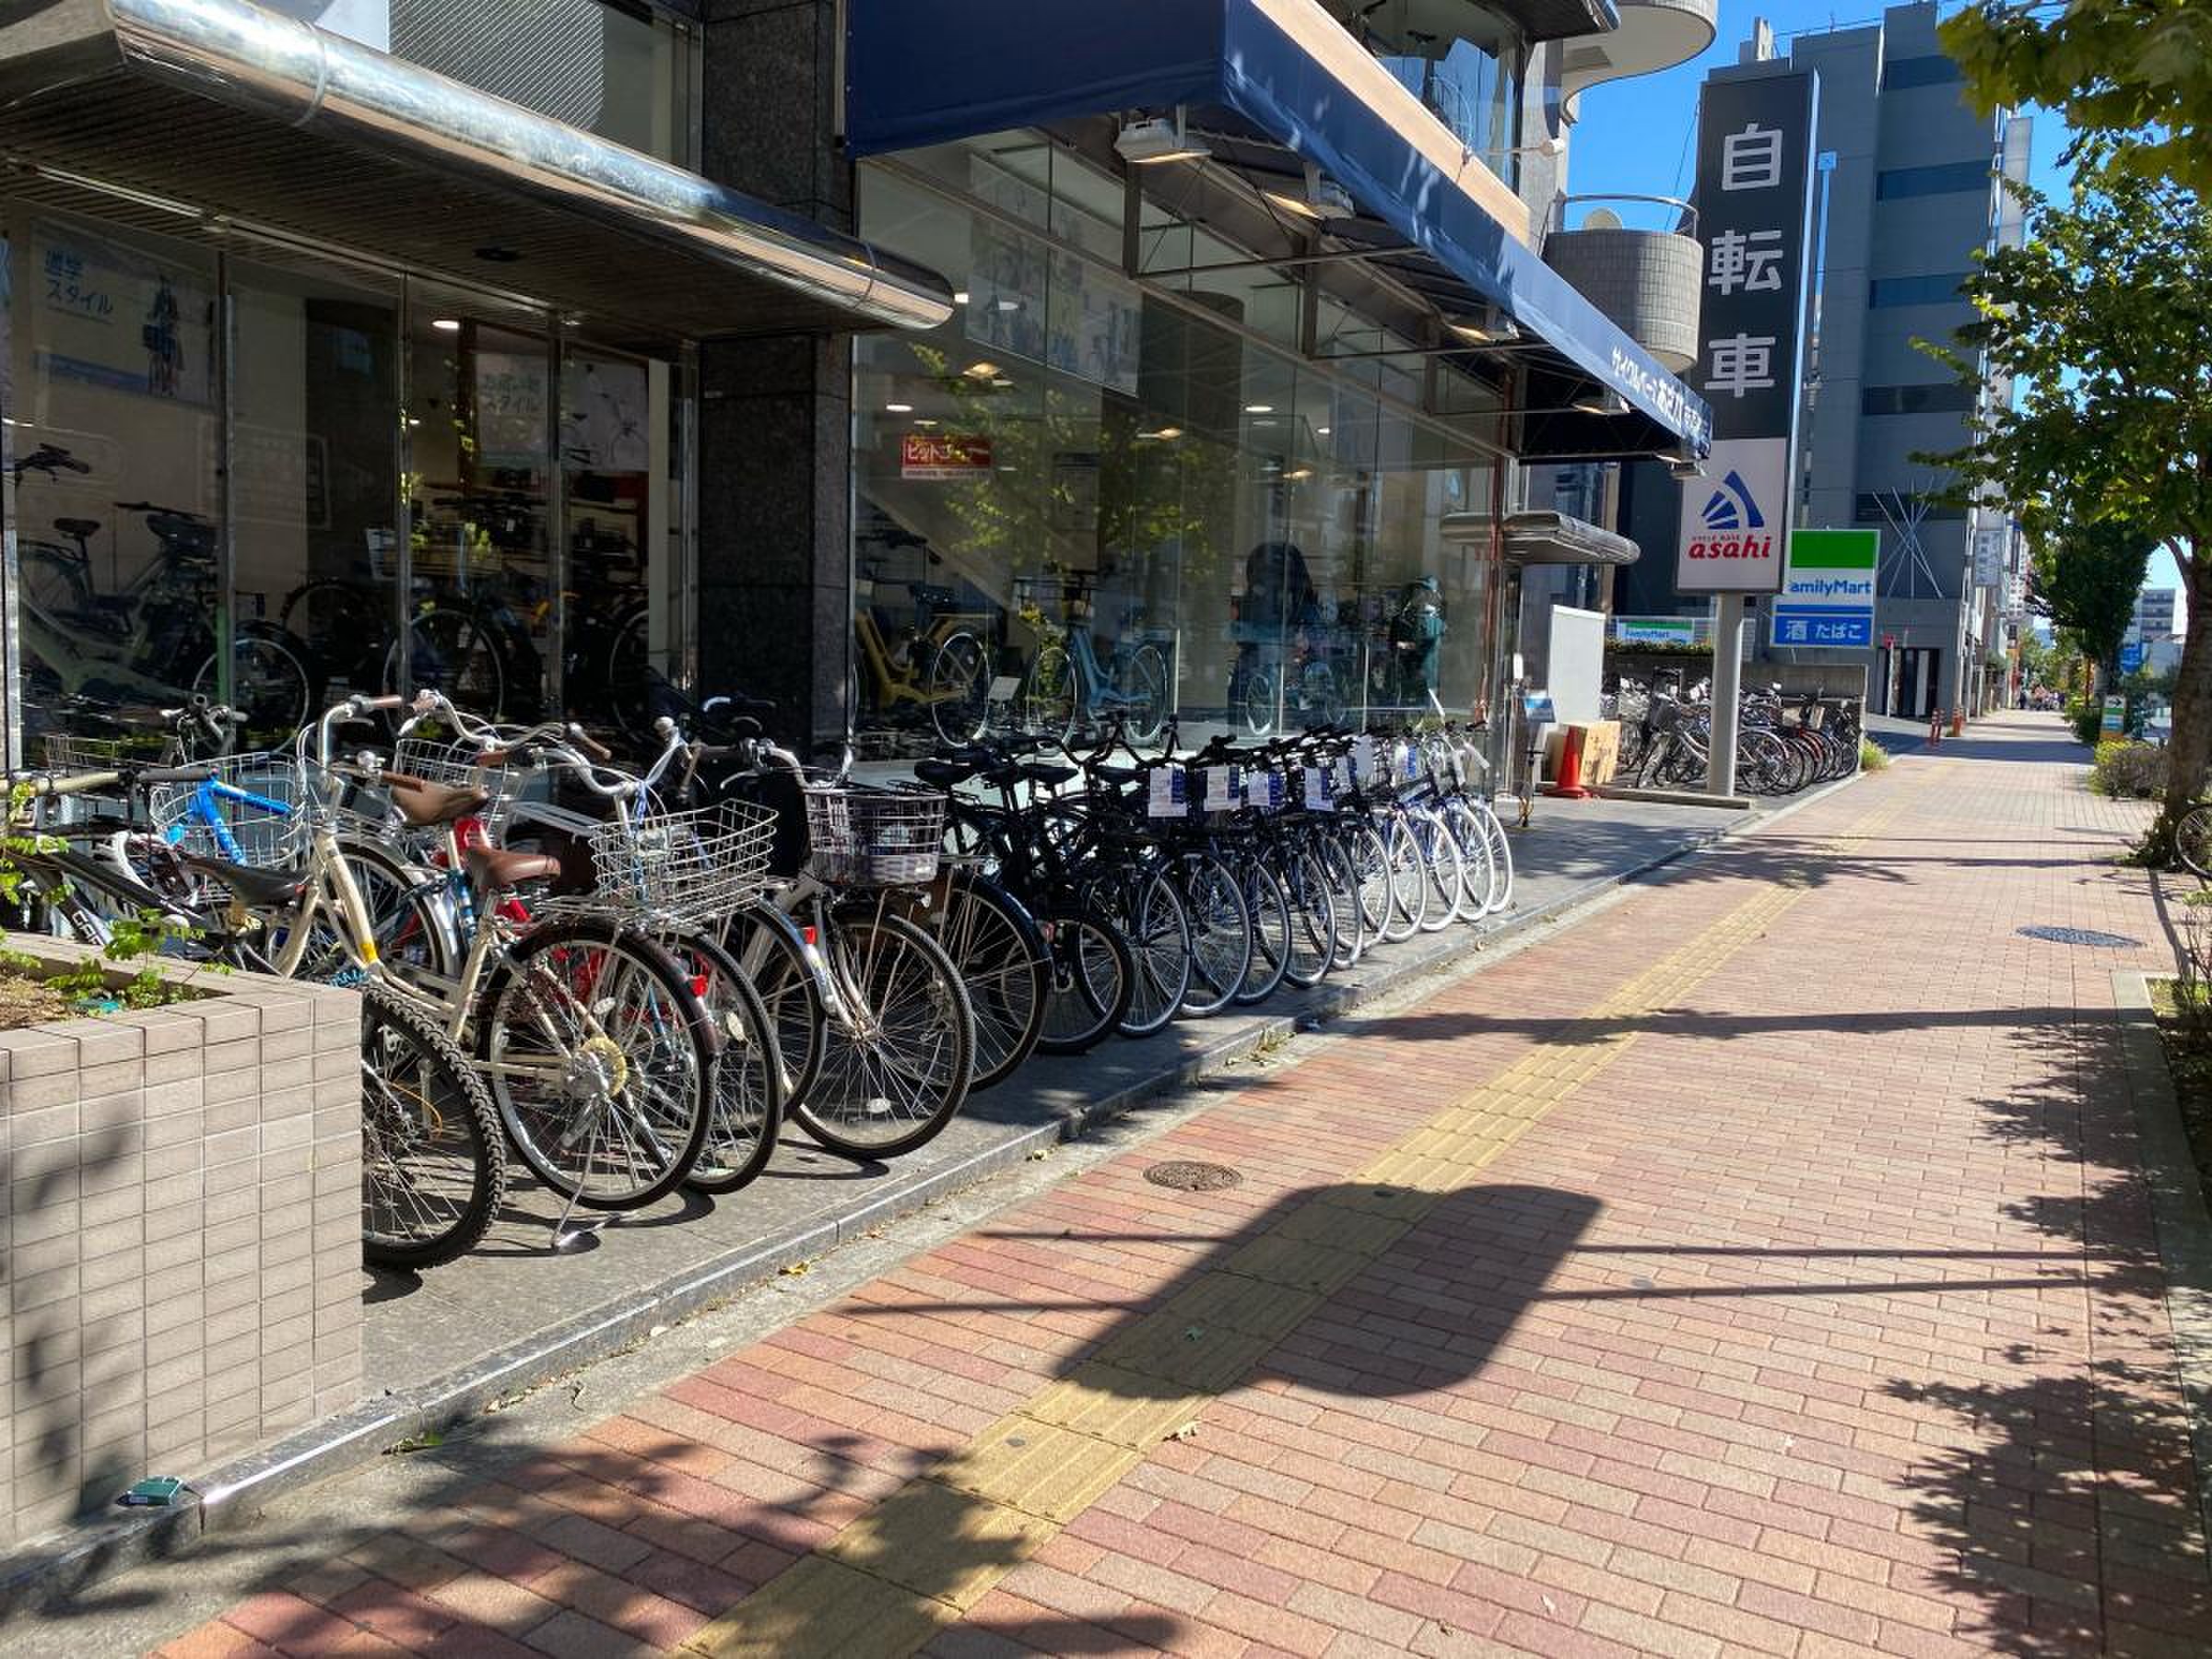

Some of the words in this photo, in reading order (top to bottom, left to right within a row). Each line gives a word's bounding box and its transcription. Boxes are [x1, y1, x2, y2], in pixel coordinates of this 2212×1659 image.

[1705, 124, 1783, 398] 自転車
[48, 278, 113, 315] スタイル
[1688, 535, 1771, 559] asahi
[1790, 580, 1871, 596] amilyMart
[1785, 619, 1807, 641] 酒
[1815, 623, 1862, 640] たばこ
